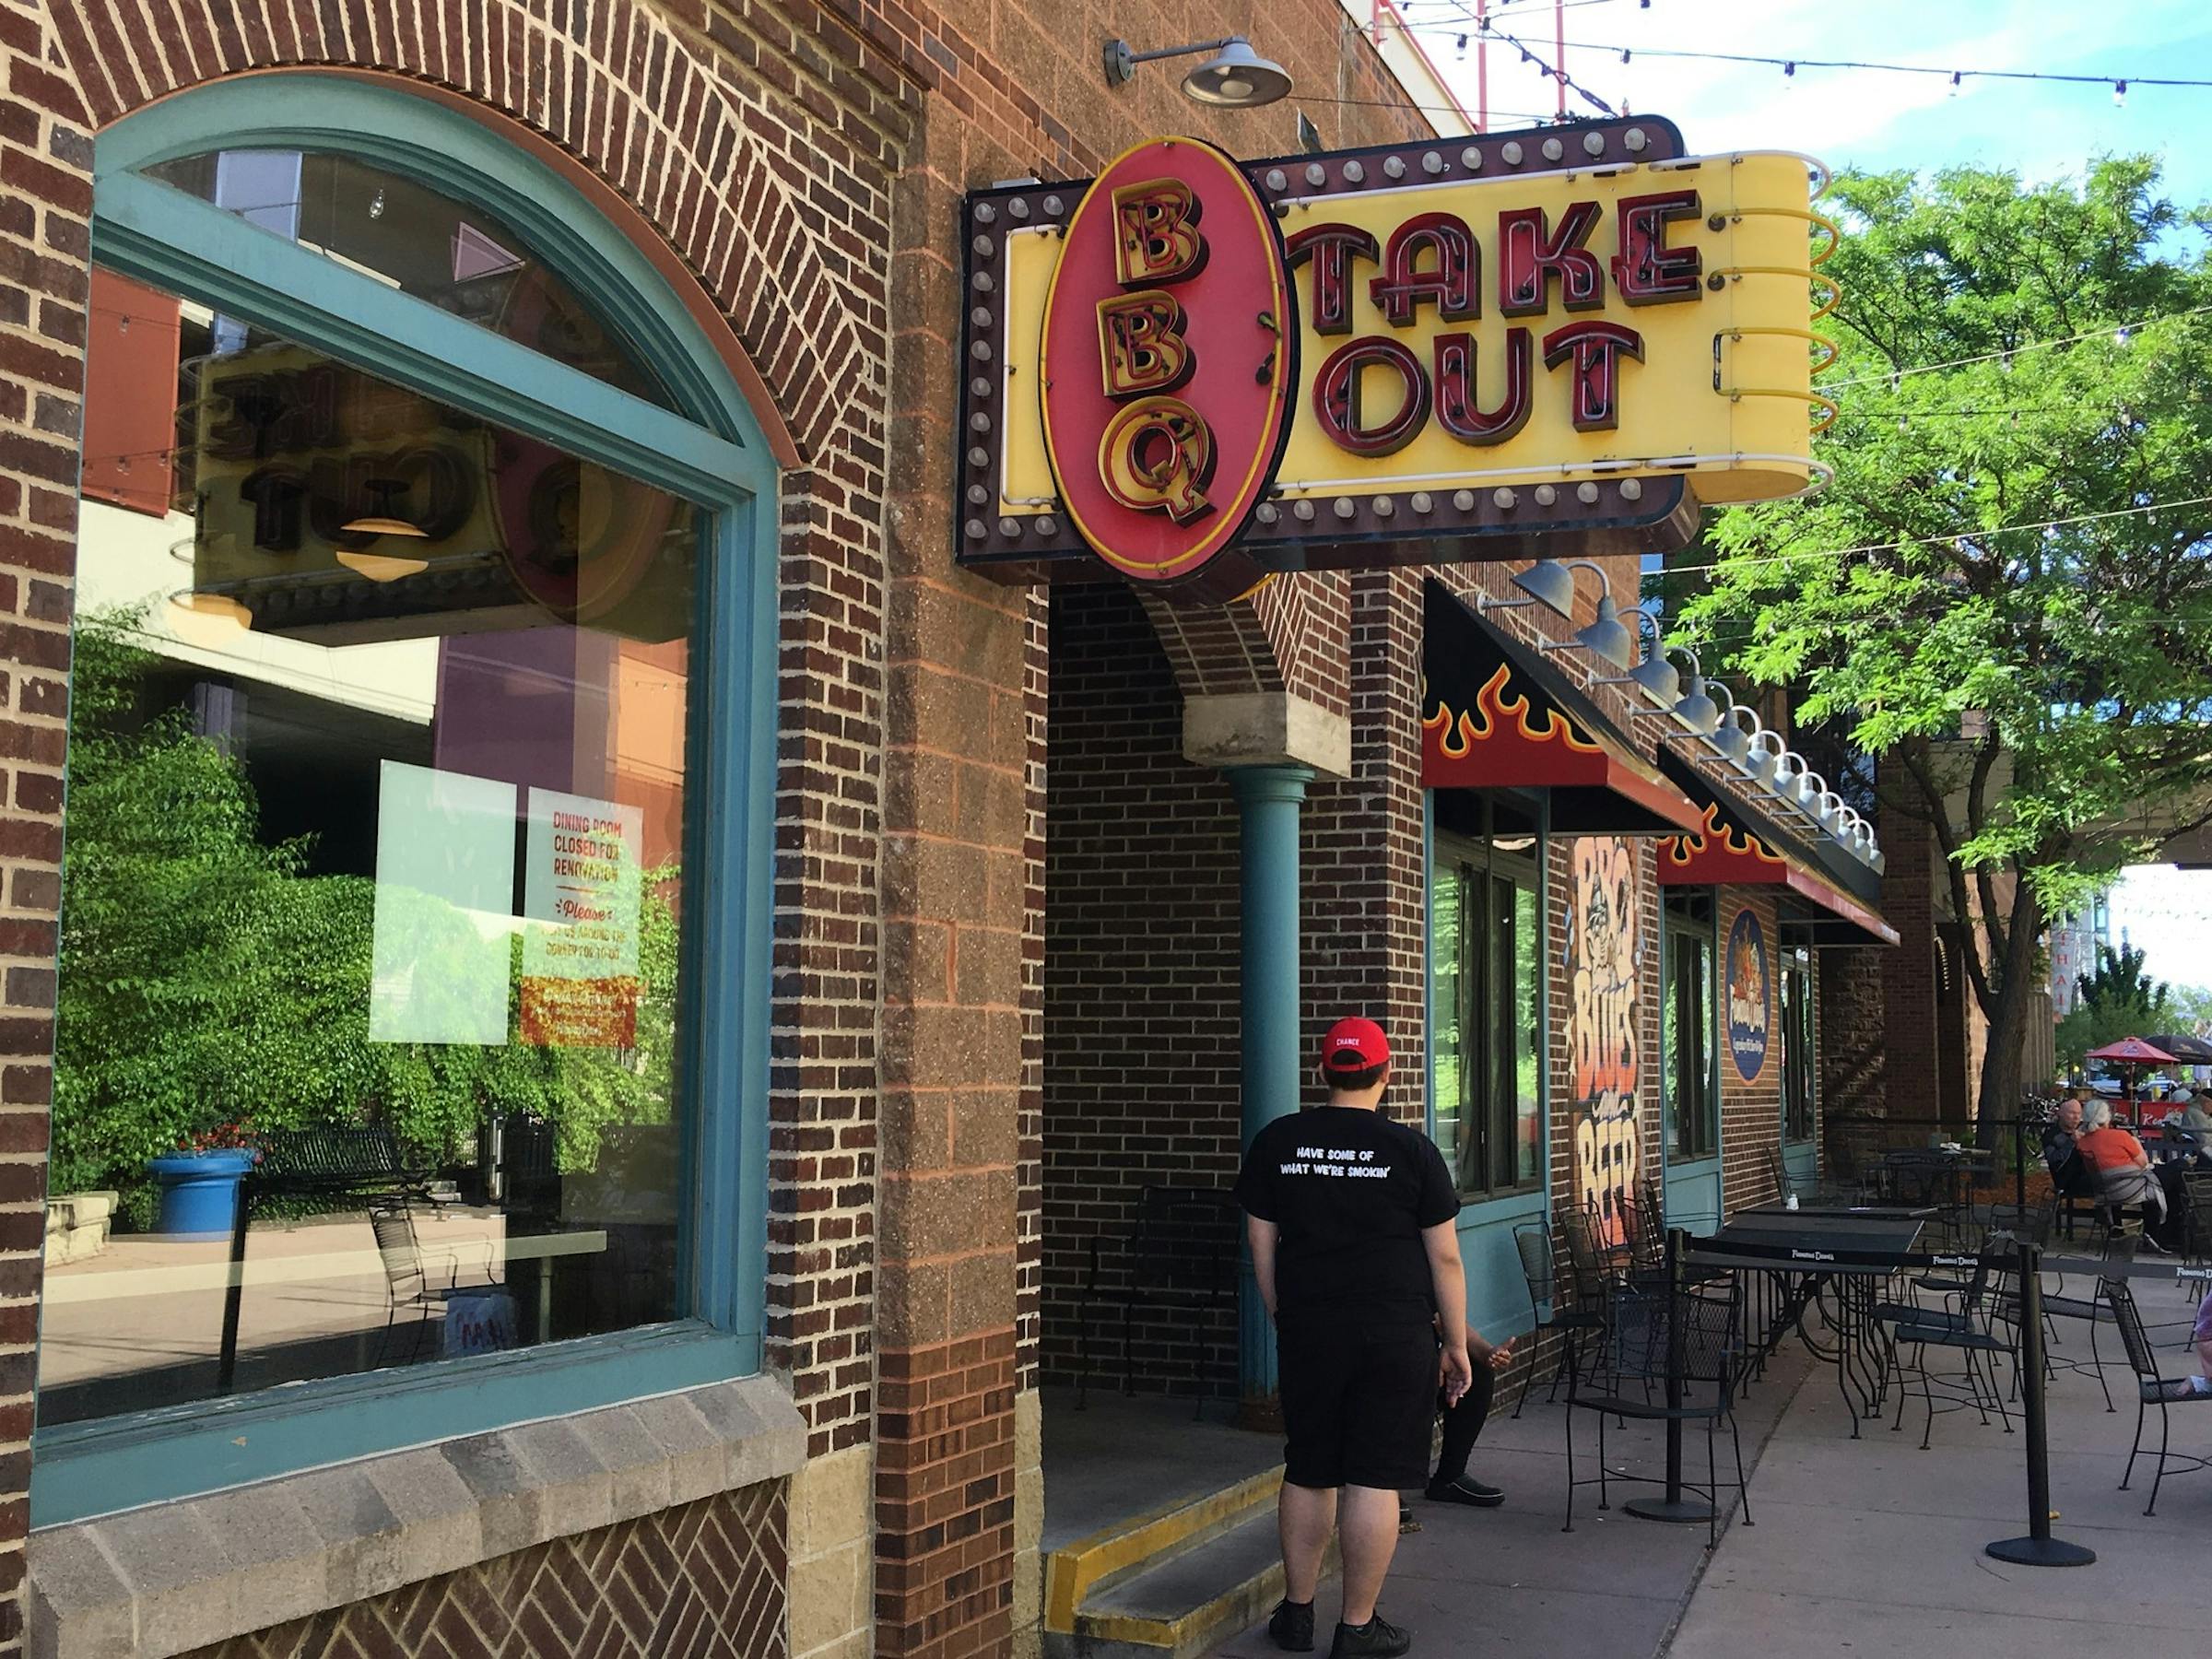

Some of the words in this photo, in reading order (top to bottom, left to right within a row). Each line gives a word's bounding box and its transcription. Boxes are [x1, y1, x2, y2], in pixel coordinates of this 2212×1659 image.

[1285, 189, 1702, 335] TAKE
[1097, 178, 1215, 527] BBQ
[1312, 321, 1645, 457] OUT
[553, 811, 590, 833] DINING
[593, 818, 622, 838] ROOM
[554, 835, 596, 857] CLOSED
[599, 842, 620, 861] FOR
[553, 858, 619, 883] RENOVATION
[563, 900, 606, 922] Please
[1574, 967, 1637, 1101] BLUES
[1296, 1147, 1324, 1159] HAVE
[1327, 1148, 1357, 1160] SOME
[1359, 1150, 1374, 1161] OF
[1280, 1163, 1310, 1175] WHAT
[1313, 1163, 1345, 1177] WE'RE
[1347, 1165, 1391, 1179] SMOKIN'
[1578, 1117, 1637, 1249] BEER
